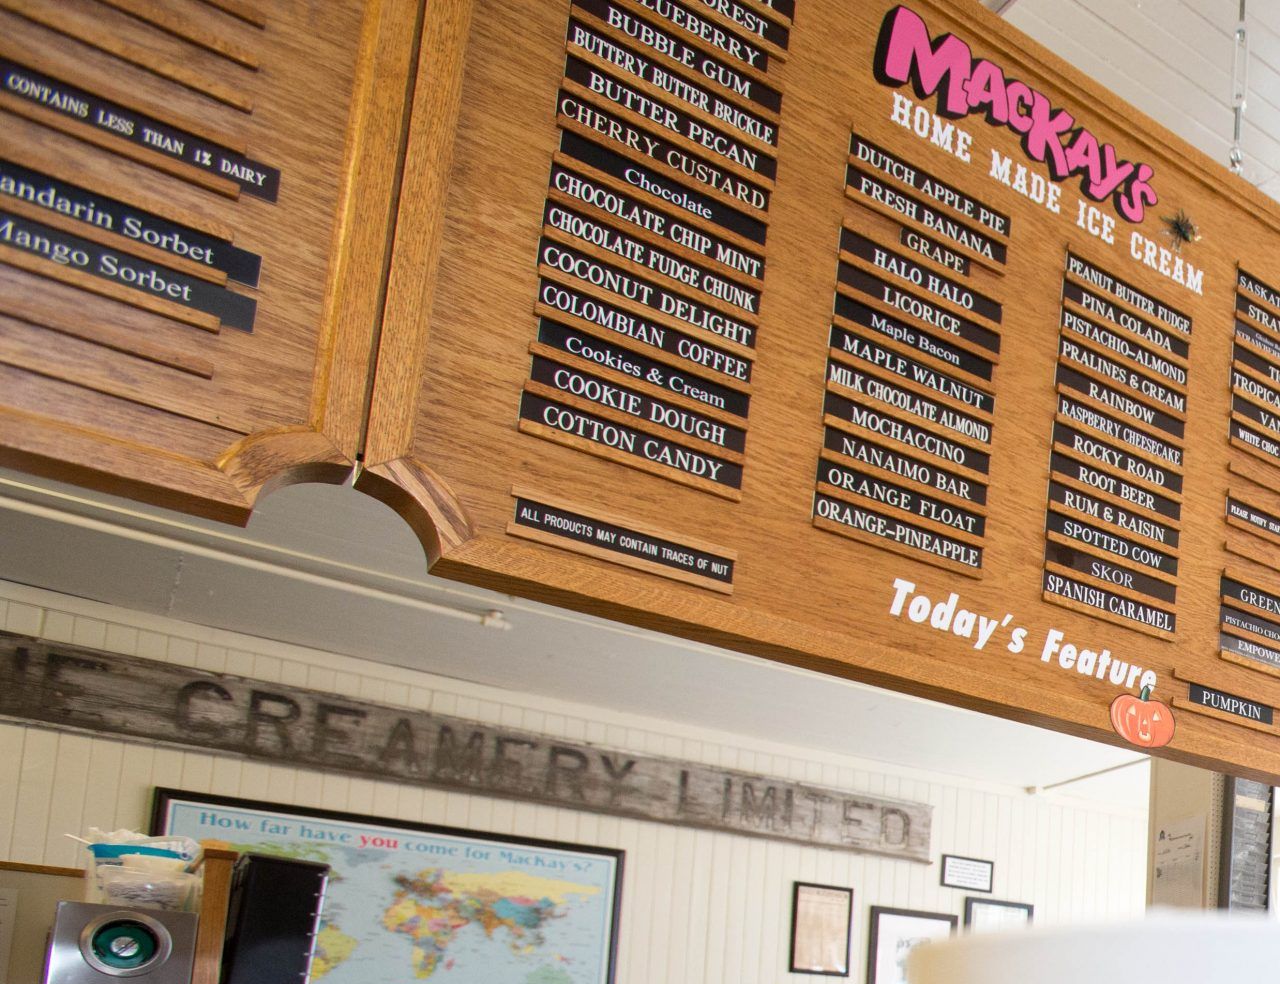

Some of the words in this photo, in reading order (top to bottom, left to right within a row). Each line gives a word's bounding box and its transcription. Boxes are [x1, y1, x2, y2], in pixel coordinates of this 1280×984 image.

[574, 26, 648, 79] BUTTERY
[653, 66, 710, 113] BUTTER
[714, 100, 773, 144] BRICKLE
[608, 6, 695, 69] BUBBLE
[702, 60, 751, 99] GUM
[7, 73, 89, 118] CONTAINS
[99, 110, 134, 136] LESS
[143, 128, 184, 155] THAN
[195, 149, 211, 167] 1%
[221, 159, 267, 187] DAIRY
[561, 98, 659, 157] CHERRY
[667, 150, 765, 210] CUSTARD
[589, 72, 680, 132] BUTTER
[687, 121, 757, 171] PECAN
[0, 175, 113, 230] andarin
[123, 217, 215, 265] Sorbet
[625, 168, 712, 220] Chocolate
[856, 142, 915, 187] DUTCH
[921, 180, 974, 217] APPLE
[979, 207, 1005, 234] PIE
[860, 176, 918, 220] FRESH
[923, 209, 994, 260] BANANA
[891, 92, 972, 163] HOME
[989, 149, 1062, 214] MADE
[1076, 199, 1116, 244] ICE
[1130, 232, 1204, 296] CREAM
[549, 207, 644, 264] CHOCOLATE
[649, 250, 699, 288] FUDGE
[703, 275, 755, 312] CHUNK
[555, 172, 665, 236] CHOCOLATE
[670, 224, 711, 254] CHIP
[717, 243, 760, 278] MINT
[907, 233, 964, 274] GRAPE
[99, 255, 193, 301] Sorbet
[544, 247, 652, 305] COCONUT
[660, 293, 751, 346] DELIGHT
[873, 249, 923, 285] HALO
[928, 274, 973, 309] HALO
[882, 286, 961, 336] LICORICE
[1070, 257, 1113, 292] PEANUT
[1115, 282, 1154, 314] BUTTER
[1157, 306, 1190, 334] FUDGE
[543, 286, 665, 348] COLOMBIAN
[678, 339, 747, 380] COFFEE
[871, 313, 915, 345] Maple
[919, 337, 960, 365] Bacon
[1064, 312, 1185, 384] PISTACHIO-ALMOND
[1082, 292, 1115, 323] PINA
[1120, 313, 1173, 352] COLADA
[565, 337, 641, 377] Cookies
[647, 369, 664, 385] &
[669, 376, 726, 409] Cream
[829, 364, 864, 393] MILK
[867, 380, 936, 421] CHOCOLATE
[940, 411, 988, 442] ALMOND
[843, 335, 907, 376] MAPLE
[912, 366, 983, 409] WALNUT
[1062, 341, 1127, 384] PRALINES
[1130, 374, 1139, 390] &
[1142, 380, 1184, 412] CREAM
[1089, 382, 1155, 424] RAINBOW
[554, 369, 642, 416] COOKIE
[649, 402, 726, 446] DOUGH
[852, 407, 965, 465] MOCHACCINO
[1061, 399, 1121, 443] RASPBERRY
[1123, 427, 1181, 465] CHEESECAKE
[543, 406, 636, 453] COTTON
[644, 441, 723, 481] CANDY
[842, 437, 930, 484] NANAIMO
[936, 472, 971, 500] BAR
[1074, 434, 1123, 469] ROCKY
[1127, 457, 1165, 487] ROAD
[1238, 428, 1260, 450] WHITE
[1261, 439, 1279, 458] CHOC
[828, 469, 911, 511] ORANGE
[919, 499, 975, 533] FLOAT
[1064, 490, 1099, 518] RUM
[1103, 507, 1113, 522] &
[1118, 511, 1165, 543] RAISIN
[1078, 465, 1116, 494] ROOT
[1120, 483, 1156, 511] BEER
[521, 507, 540, 522] ALL
[544, 514, 592, 538] PRODUCTS
[597, 529, 616, 544] MAY
[620, 536, 657, 556] CONTAIN
[662, 547, 694, 567] TRACES
[697, 558, 708, 570] OF
[712, 563, 728, 577] NUT
[817, 499, 978, 567] ORANGE-PINEAPPLE
[1063, 520, 1129, 557] SPOTTED
[1131, 546, 1162, 569] COW
[1047, 574, 1105, 609] SPANISH
[1109, 596, 1172, 631] CARAMEL
[1091, 562, 1134, 589] SKOR
[889, 578, 1028, 654] Today's
[1040, 628, 1157, 693] Feature
[1225, 616, 1263, 634] PISTACHIO
[1202, 690, 1261, 720] PUMPKIN
[175, 680, 637, 808] CREAMERY
[677, 769, 911, 848] LIMITED
[200, 811, 250, 831] How
[260, 819, 290, 836] far
[299, 825, 352, 843] have
[358, 834, 399, 849] you
[405, 842, 459, 857] come
[464, 848, 491, 860] for
